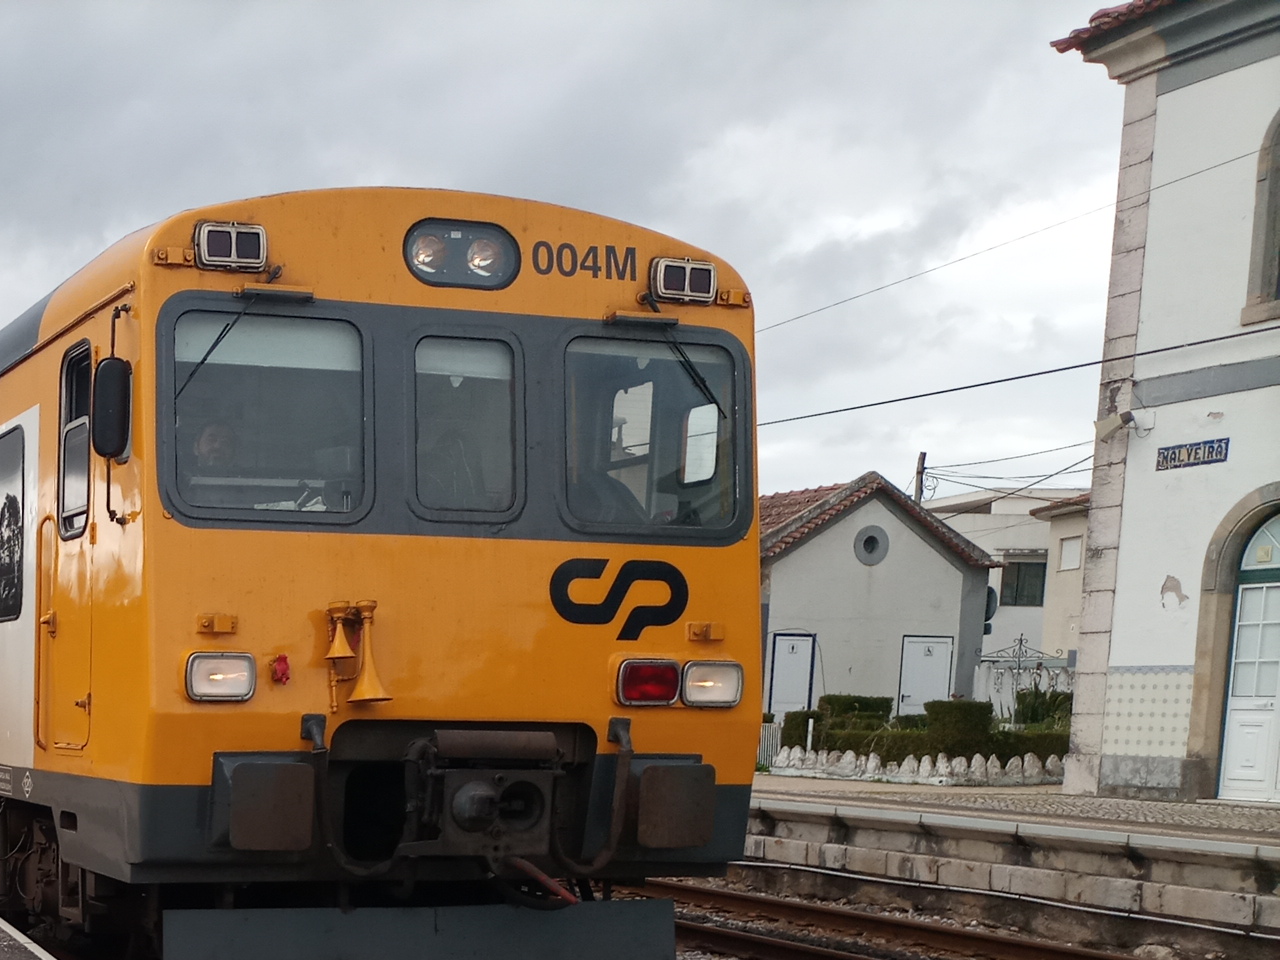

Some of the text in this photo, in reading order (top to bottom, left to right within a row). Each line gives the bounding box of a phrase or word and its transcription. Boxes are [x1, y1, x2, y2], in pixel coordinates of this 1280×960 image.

[532, 240, 637, 282] 004M
[1161, 443, 1223, 465] MALVEIRA
[549, 558, 689, 641] CP
